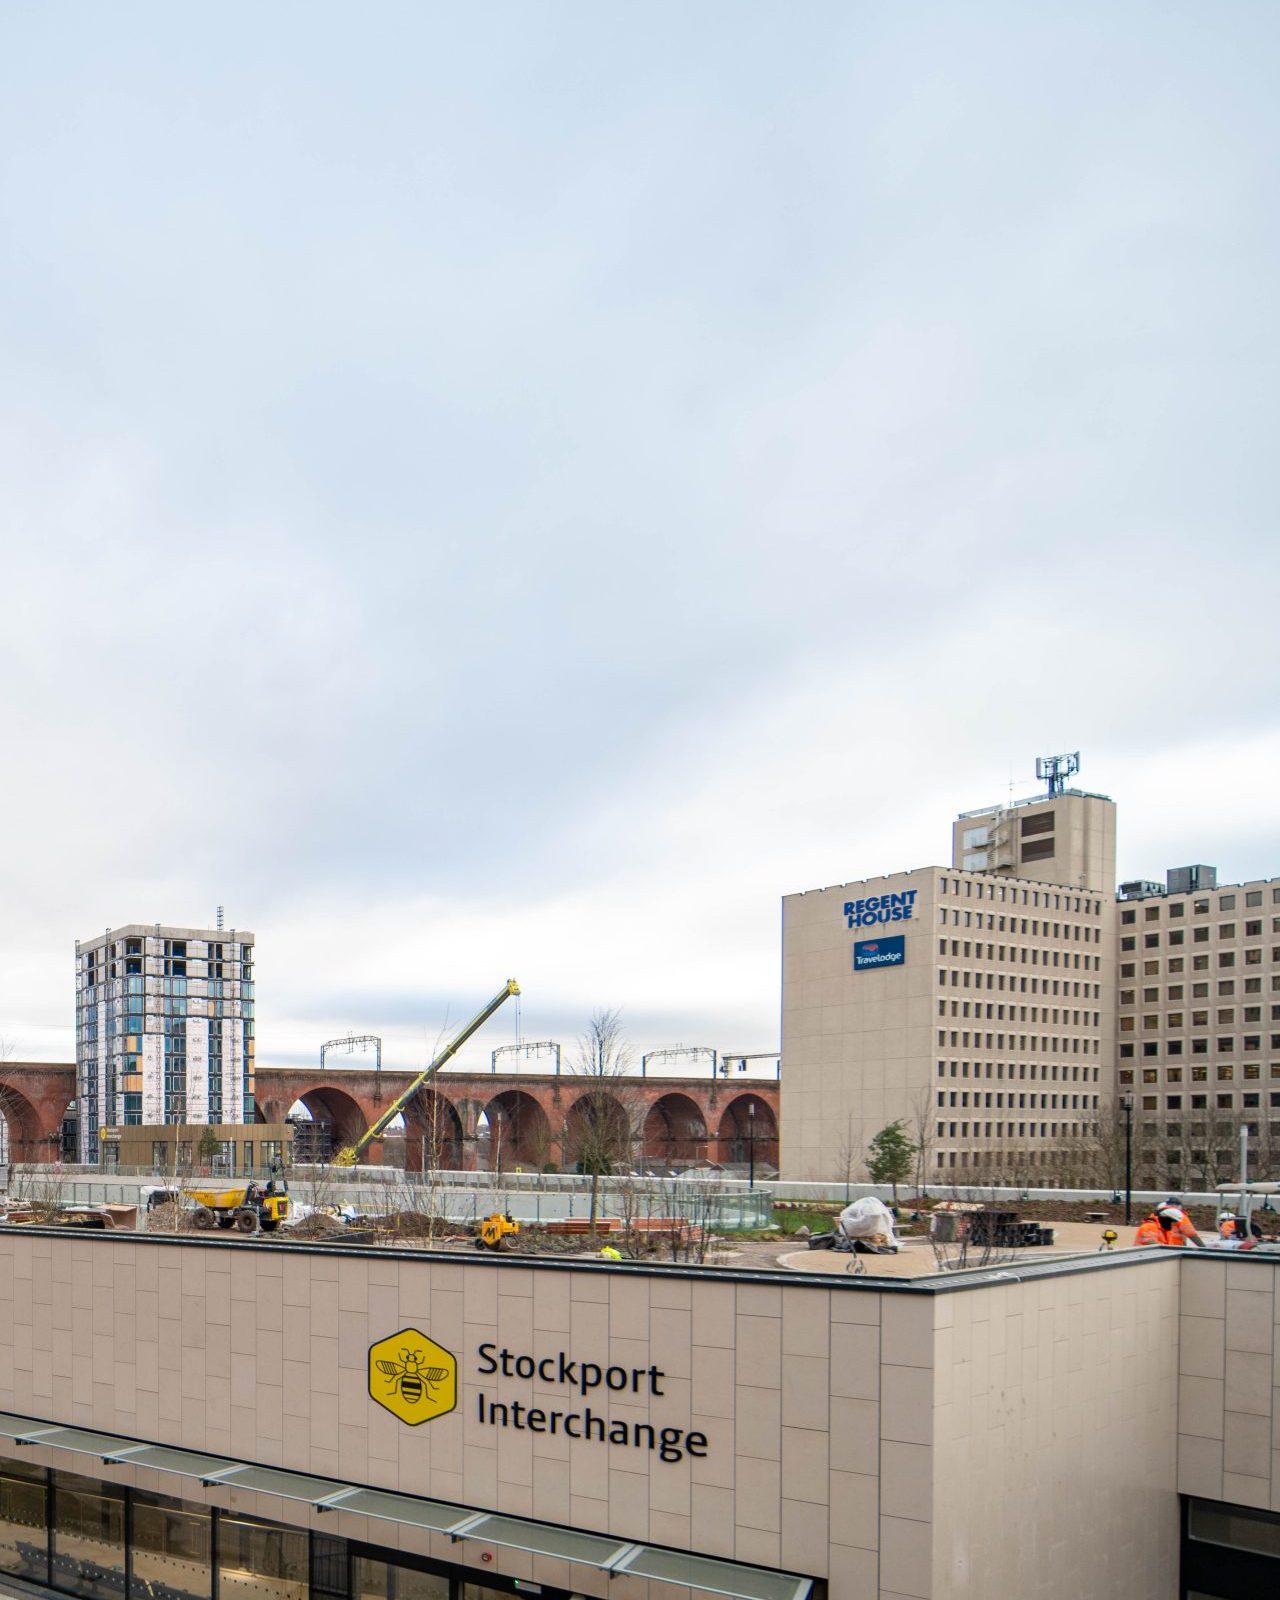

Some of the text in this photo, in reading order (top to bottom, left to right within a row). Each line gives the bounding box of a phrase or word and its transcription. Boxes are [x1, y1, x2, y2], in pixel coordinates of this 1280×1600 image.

[844, 890, 917, 916] REGENT
[848, 905, 912, 928] HOUSE
[856, 952, 902, 965] Travelodge
[478, 1343, 665, 1396] Stockport
[478, 1393, 708, 1463] Interchange
